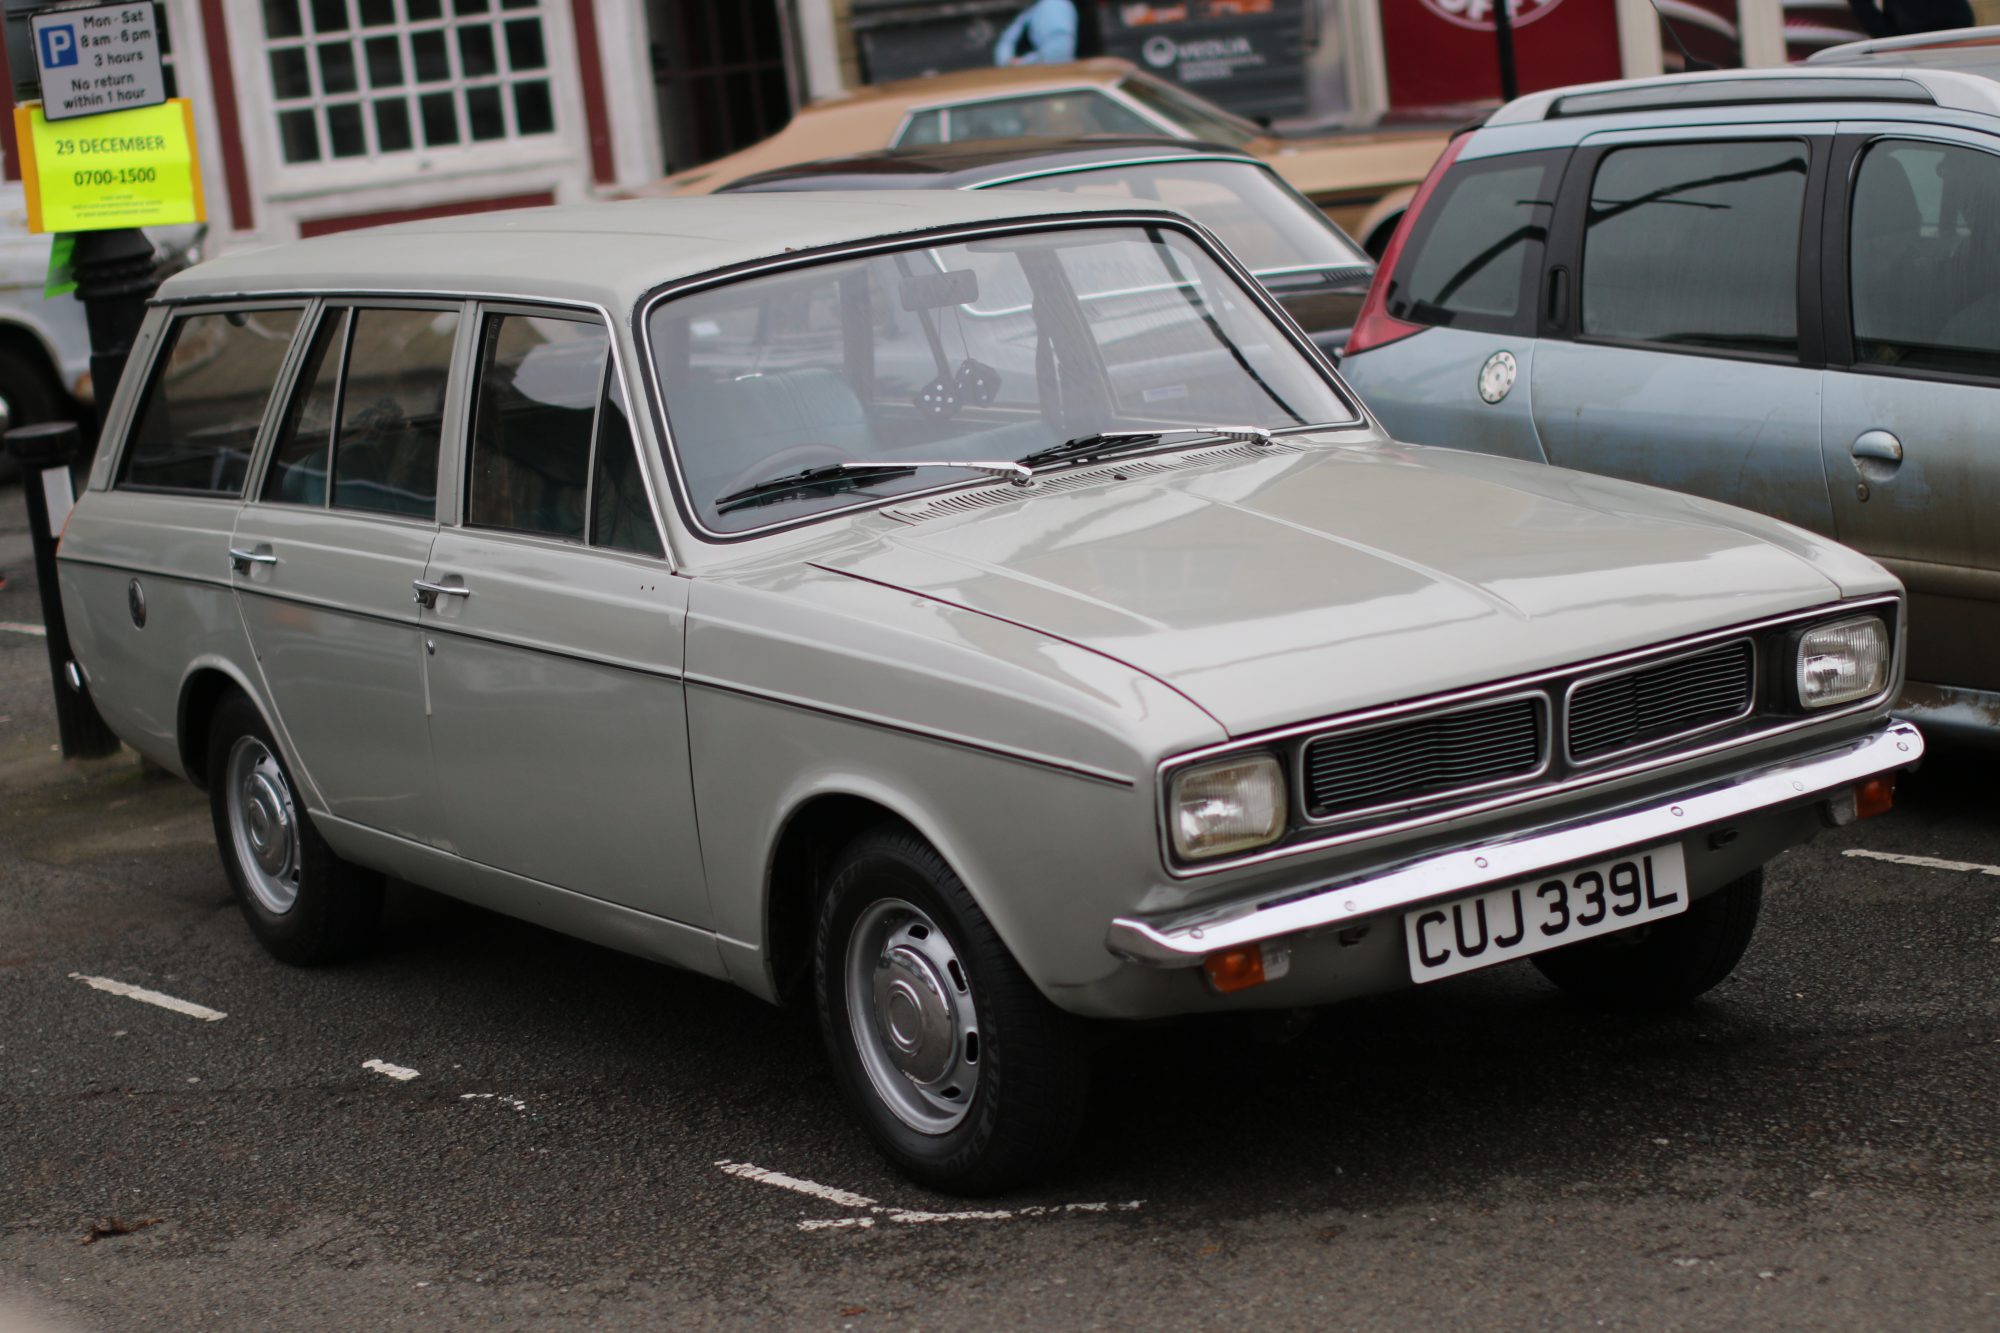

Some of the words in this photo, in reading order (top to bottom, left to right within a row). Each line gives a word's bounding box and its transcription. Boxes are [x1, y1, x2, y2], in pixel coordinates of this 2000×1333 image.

[83, 15, 111, 29] Mon
[121, 10, 144, 24] Sat
[47, 30, 71, 65] P
[94, 53, 103, 67] 3
[107, 50, 144, 65] hours
[71, 79, 90, 92] No
[94, 73, 135, 88] return
[64, 94, 103, 109] within
[107, 91, 112, 103] 1
[117, 88, 146, 101] hour
[56, 139, 75, 155] 29
[79, 135, 166, 154] DECEMBER
[74, 167, 156, 187] 0700-1500
[1416, 889, 1525, 968] CUJ
[1536, 855, 1679, 937] 339L
